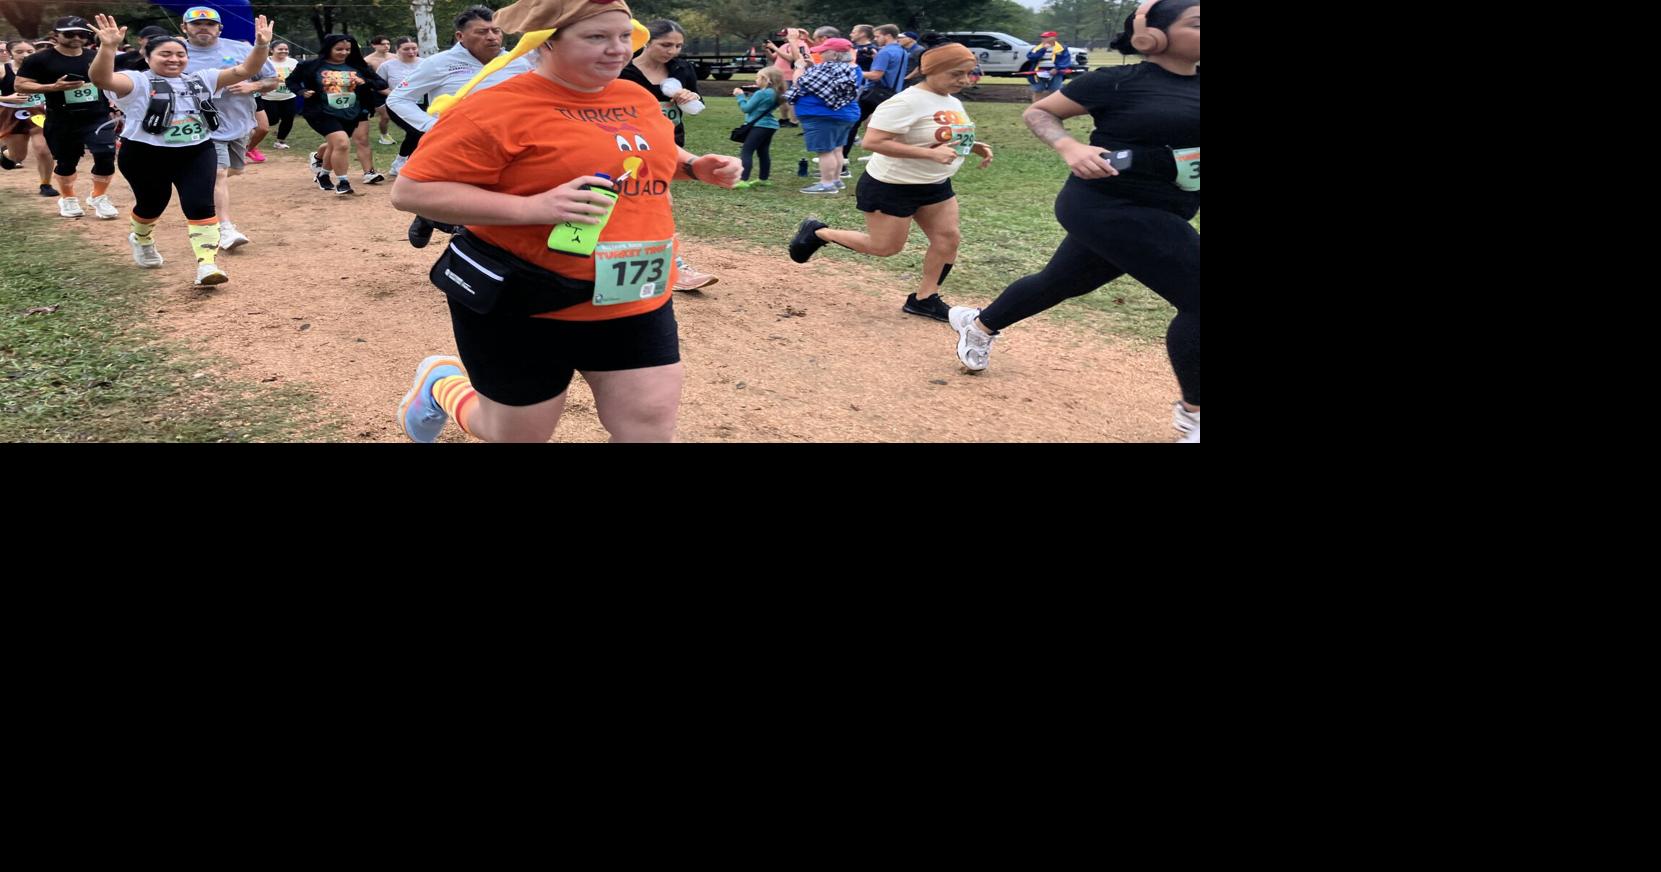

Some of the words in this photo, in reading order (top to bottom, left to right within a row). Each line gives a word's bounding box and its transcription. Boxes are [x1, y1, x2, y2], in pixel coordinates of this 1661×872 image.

[73, 88, 93, 98] 89
[335, 97, 350, 105] 67
[555, 105, 639, 123] TURKEY
[170, 123, 202, 137] 263
[612, 258, 665, 287] 173
